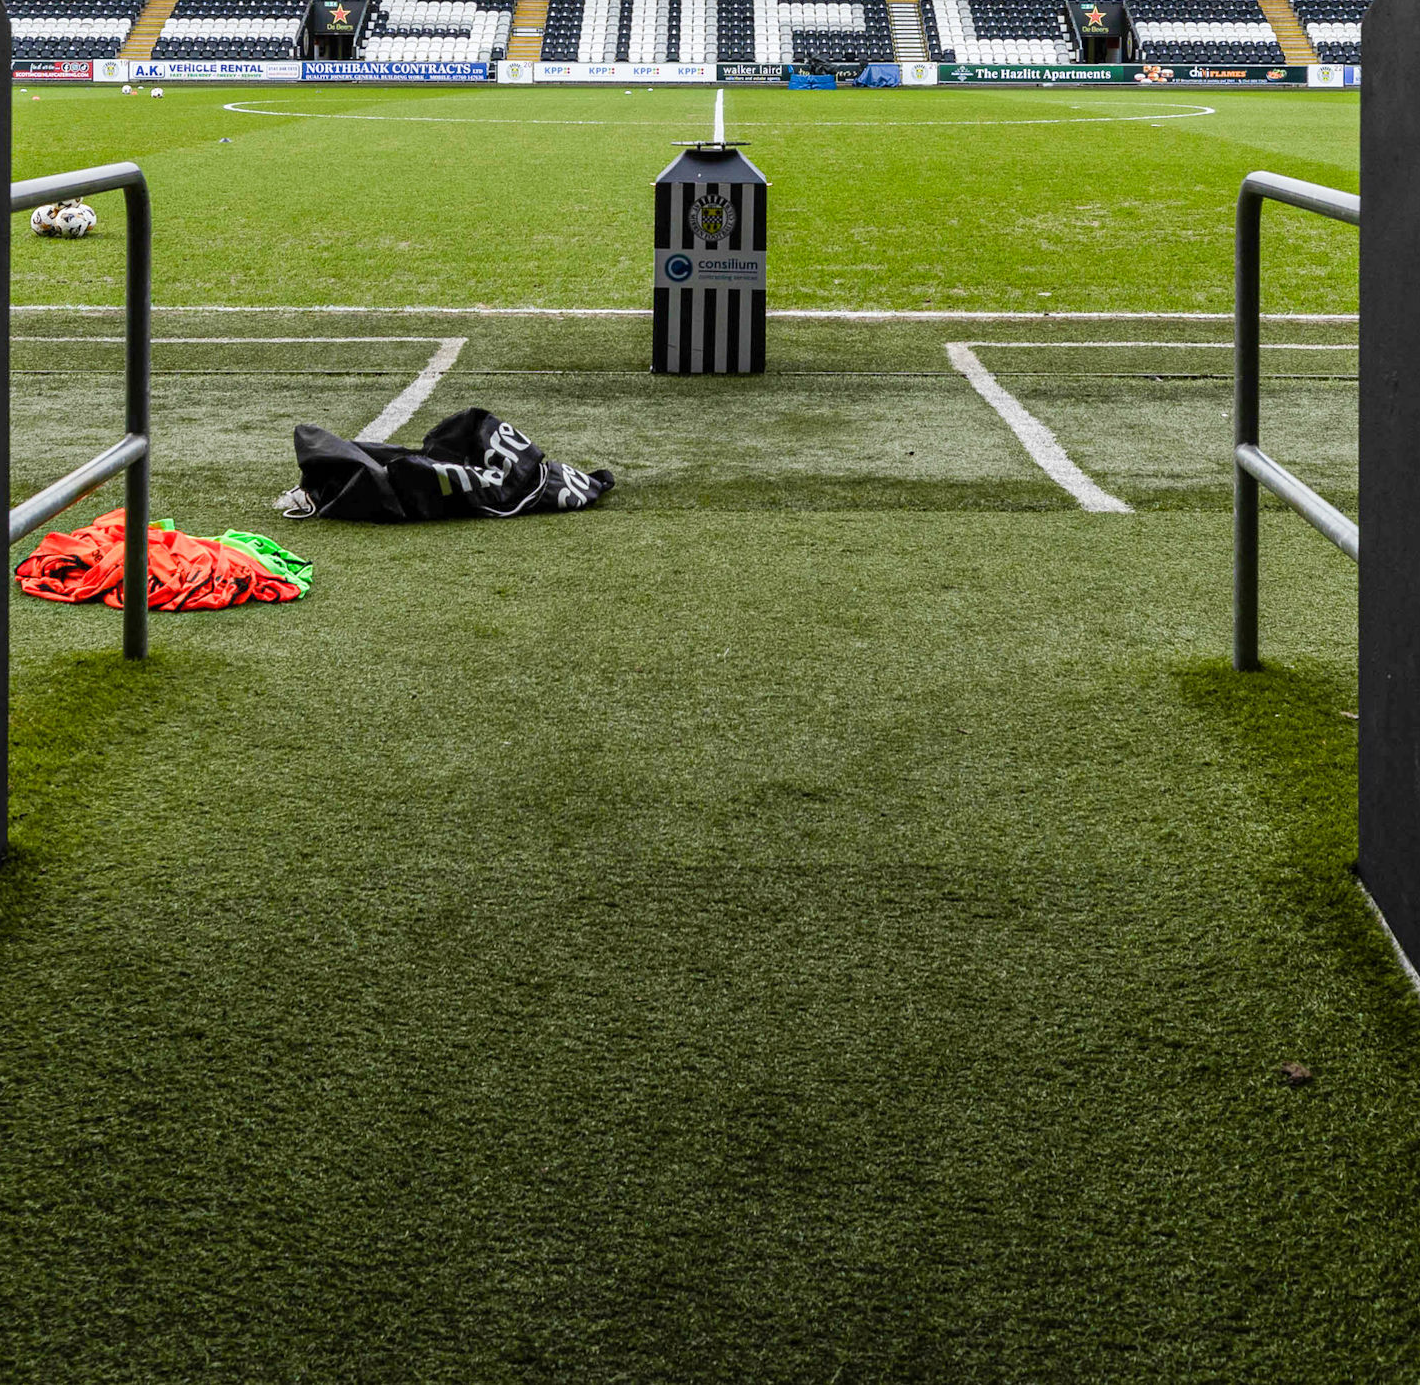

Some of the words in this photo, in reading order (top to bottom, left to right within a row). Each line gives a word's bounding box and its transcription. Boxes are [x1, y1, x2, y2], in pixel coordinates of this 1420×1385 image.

[135, 65, 163, 76] A.K.
[169, 64, 217, 73] VEHICLE
[220, 64, 264, 73] RENTAL
[306, 63, 390, 74] NORTHBANK
[392, 63, 471, 74] CONTRACTS
[723, 65, 756, 74] walker
[759, 65, 782, 74] laird
[1209, 70, 1247, 78] FLAMES
[975, 68, 998, 79] The
[1001, 68, 1040, 79] Hazlitt
[1043, 69, 1112, 81] Apartments
[698, 258, 758, 270] consilium
